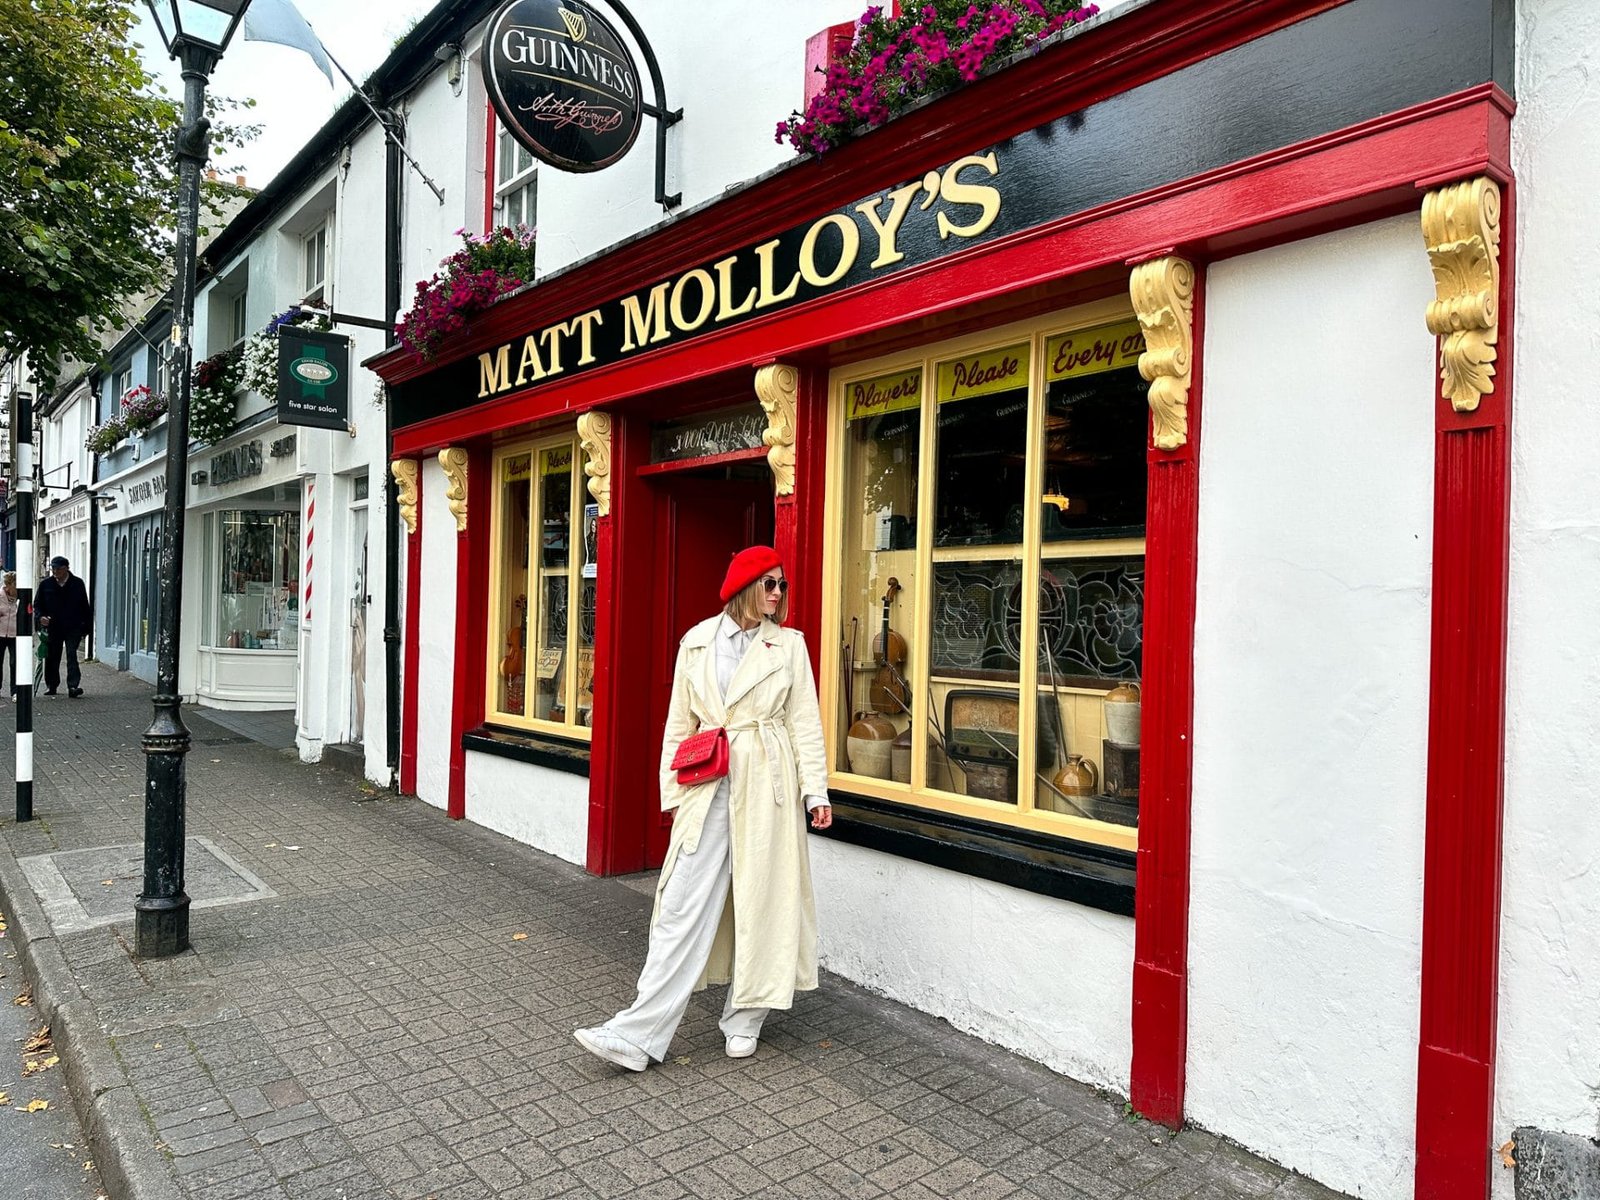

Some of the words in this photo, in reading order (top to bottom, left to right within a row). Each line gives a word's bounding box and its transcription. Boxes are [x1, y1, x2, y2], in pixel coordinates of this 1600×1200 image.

[501, 29, 635, 100] GUINNESS
[477, 308, 604, 399] MATT
[619, 150, 1003, 354] MOLLOY'S
[288, 400, 301, 408] five
[318, 405, 337, 413] salon
[852, 374, 920, 415] Player's
[951, 356, 1019, 397] Please
